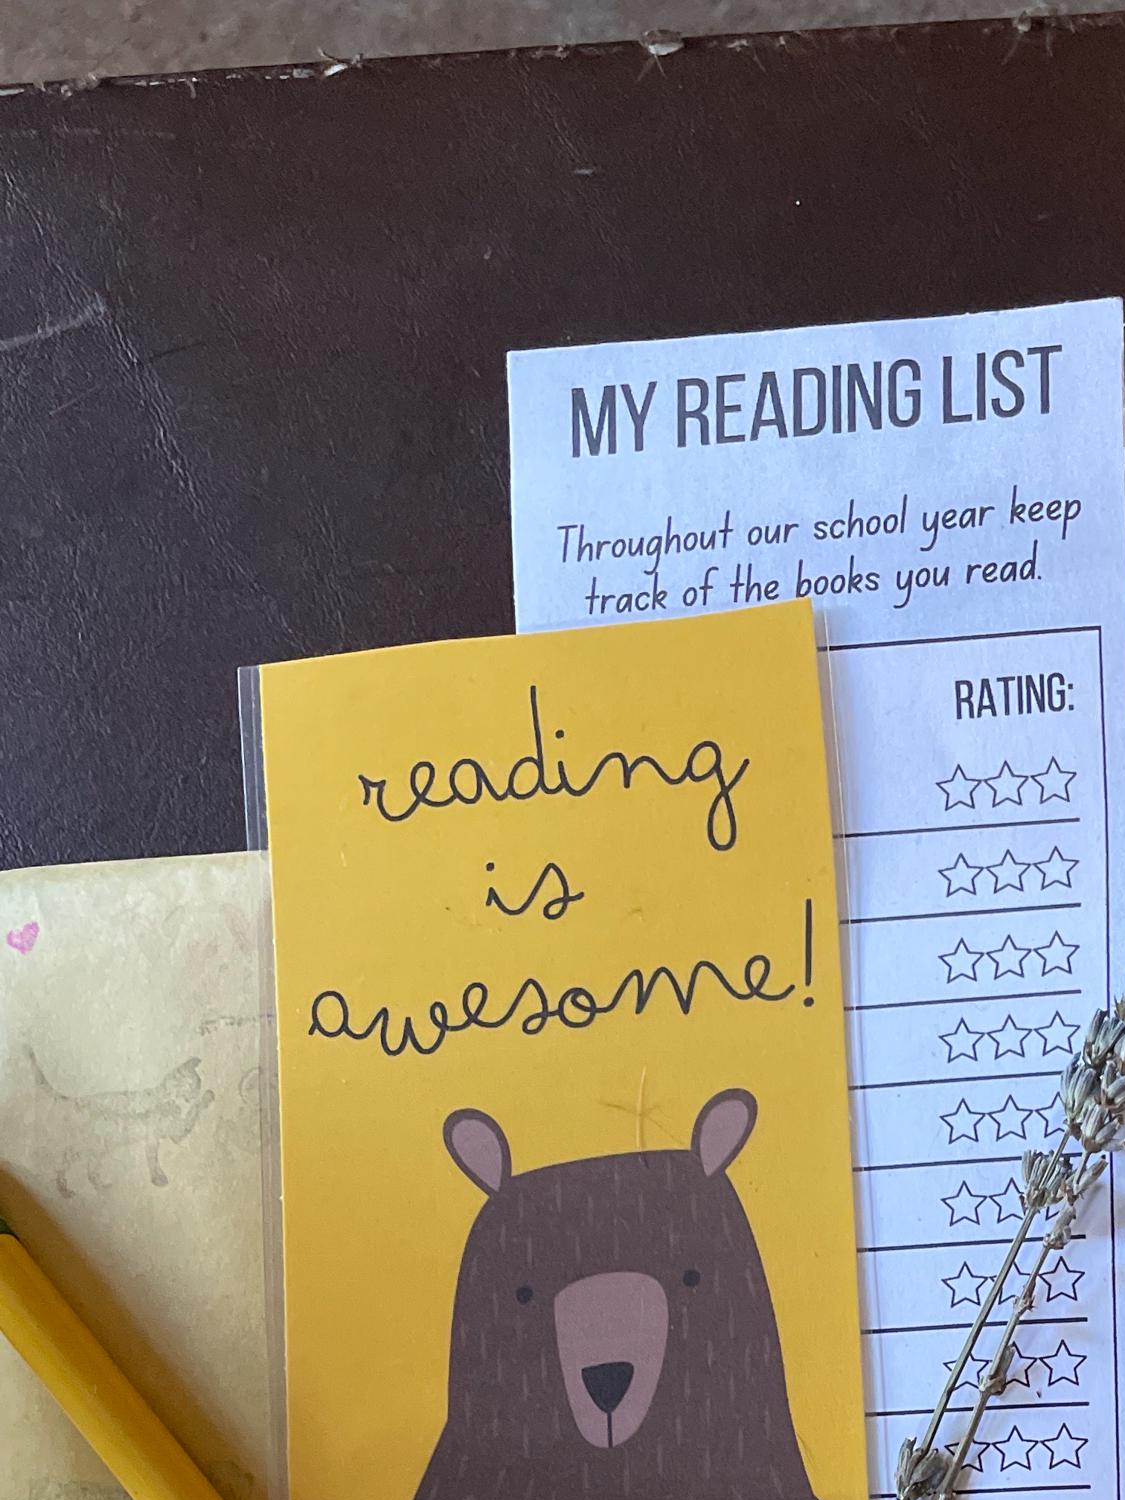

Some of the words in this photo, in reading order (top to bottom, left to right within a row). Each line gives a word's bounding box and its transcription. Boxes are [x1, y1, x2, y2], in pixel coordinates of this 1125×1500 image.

[570, 380, 658, 459] MY
[676, 358, 922, 449] READING
[941, 344, 1063, 425] LIST
[557, 510, 733, 575] Throughout
[747, 521, 800, 548] our
[812, 494, 907, 540] school
[921, 503, 995, 552] year
[1009, 485, 1083, 539] keep
[584, 572, 669, 615] track
[681, 568, 716, 607] of
[729, 565, 780, 603] the
[795, 556, 881, 599] books
[895, 567, 951, 610] you
[965, 540, 1044, 583] read.
[953, 671, 1076, 719] RATING:
[358, 684, 751, 851] reading
[485, 862, 585, 920] is
[308, 898, 816, 1056] awesome!
